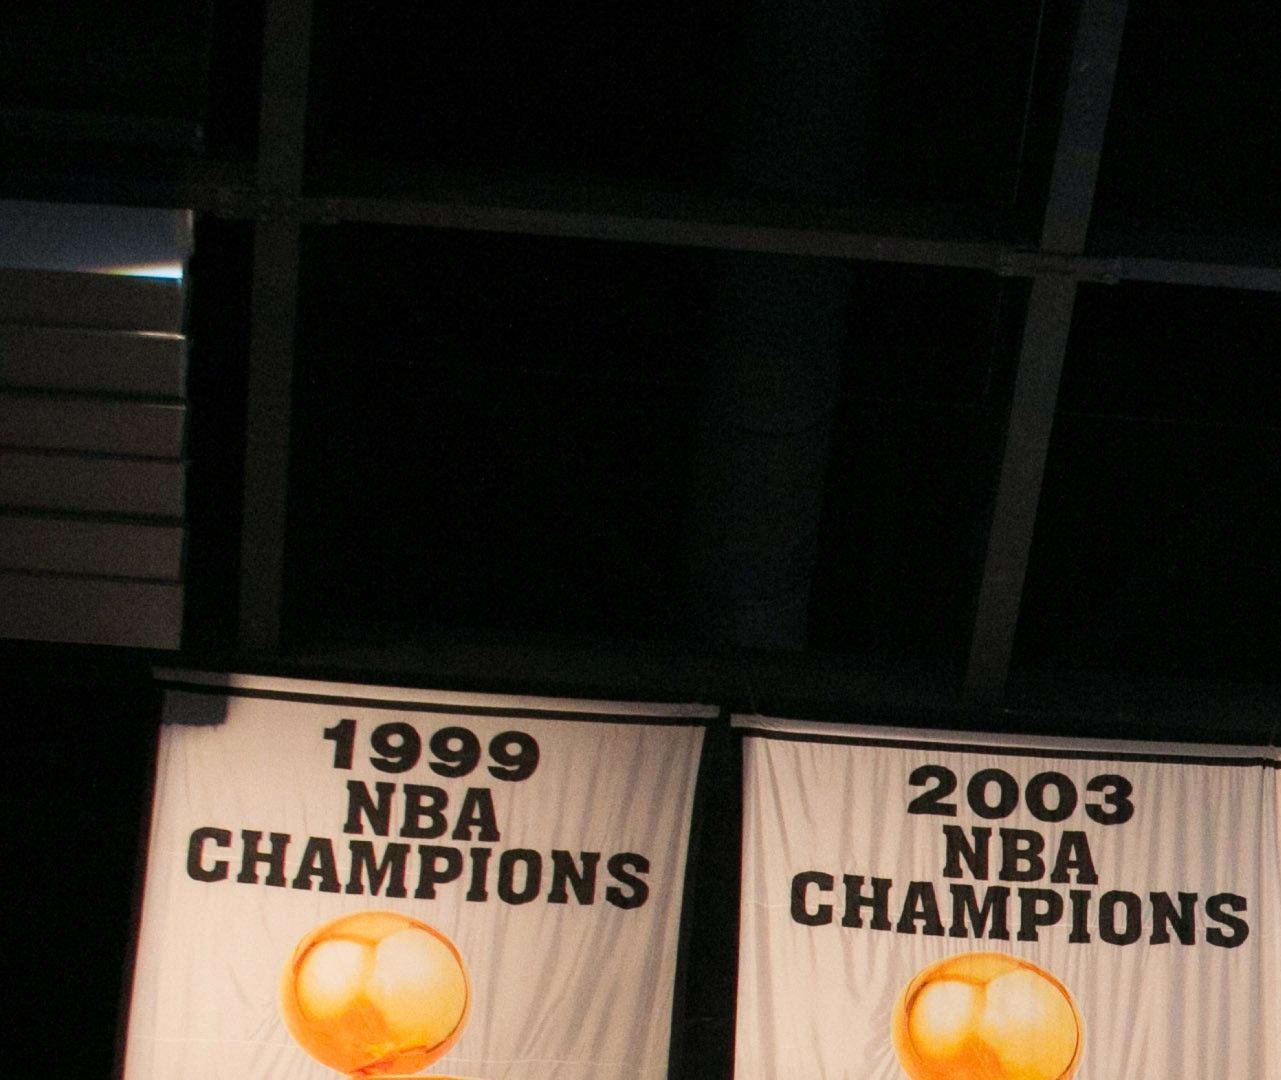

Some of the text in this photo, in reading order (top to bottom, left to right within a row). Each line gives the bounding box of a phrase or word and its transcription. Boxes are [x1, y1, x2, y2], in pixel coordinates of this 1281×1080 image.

[322, 719, 540, 781] 1999
[343, 780, 501, 842] NBA
[907, 765, 1135, 825] 2003
[186, 828, 650, 910] CHAMPIONS
[942, 825, 1098, 884] NBA
[790, 871, 1250, 948] CHAMPIONS
